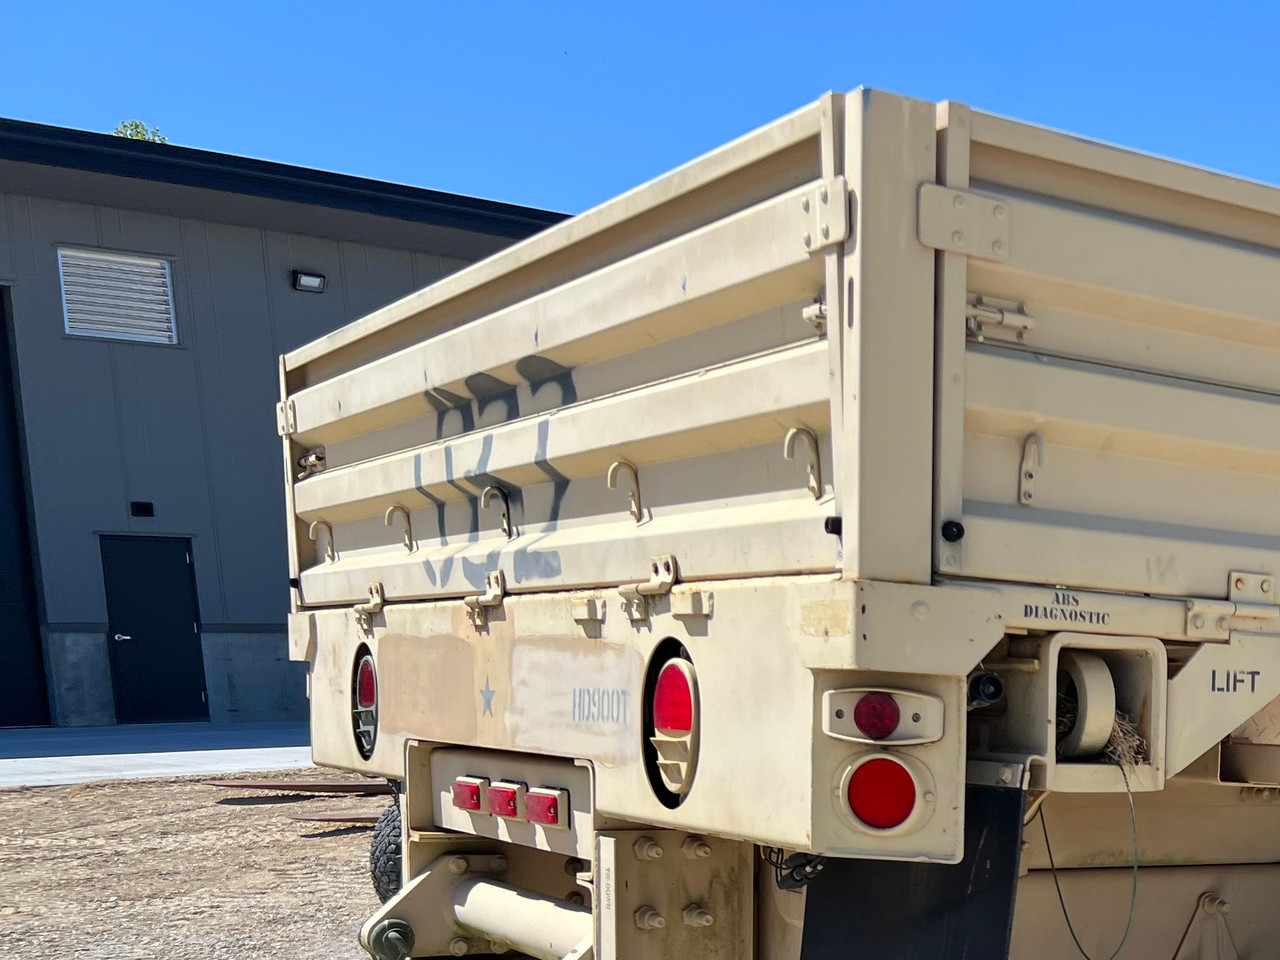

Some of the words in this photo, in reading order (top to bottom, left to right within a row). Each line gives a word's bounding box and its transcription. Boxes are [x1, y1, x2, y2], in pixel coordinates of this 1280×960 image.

[1052, 591, 1080, 607] ABS
[1024, 604, 1110, 626] DIAGNOSTIC
[1211, 669, 1260, 693] LIFT
